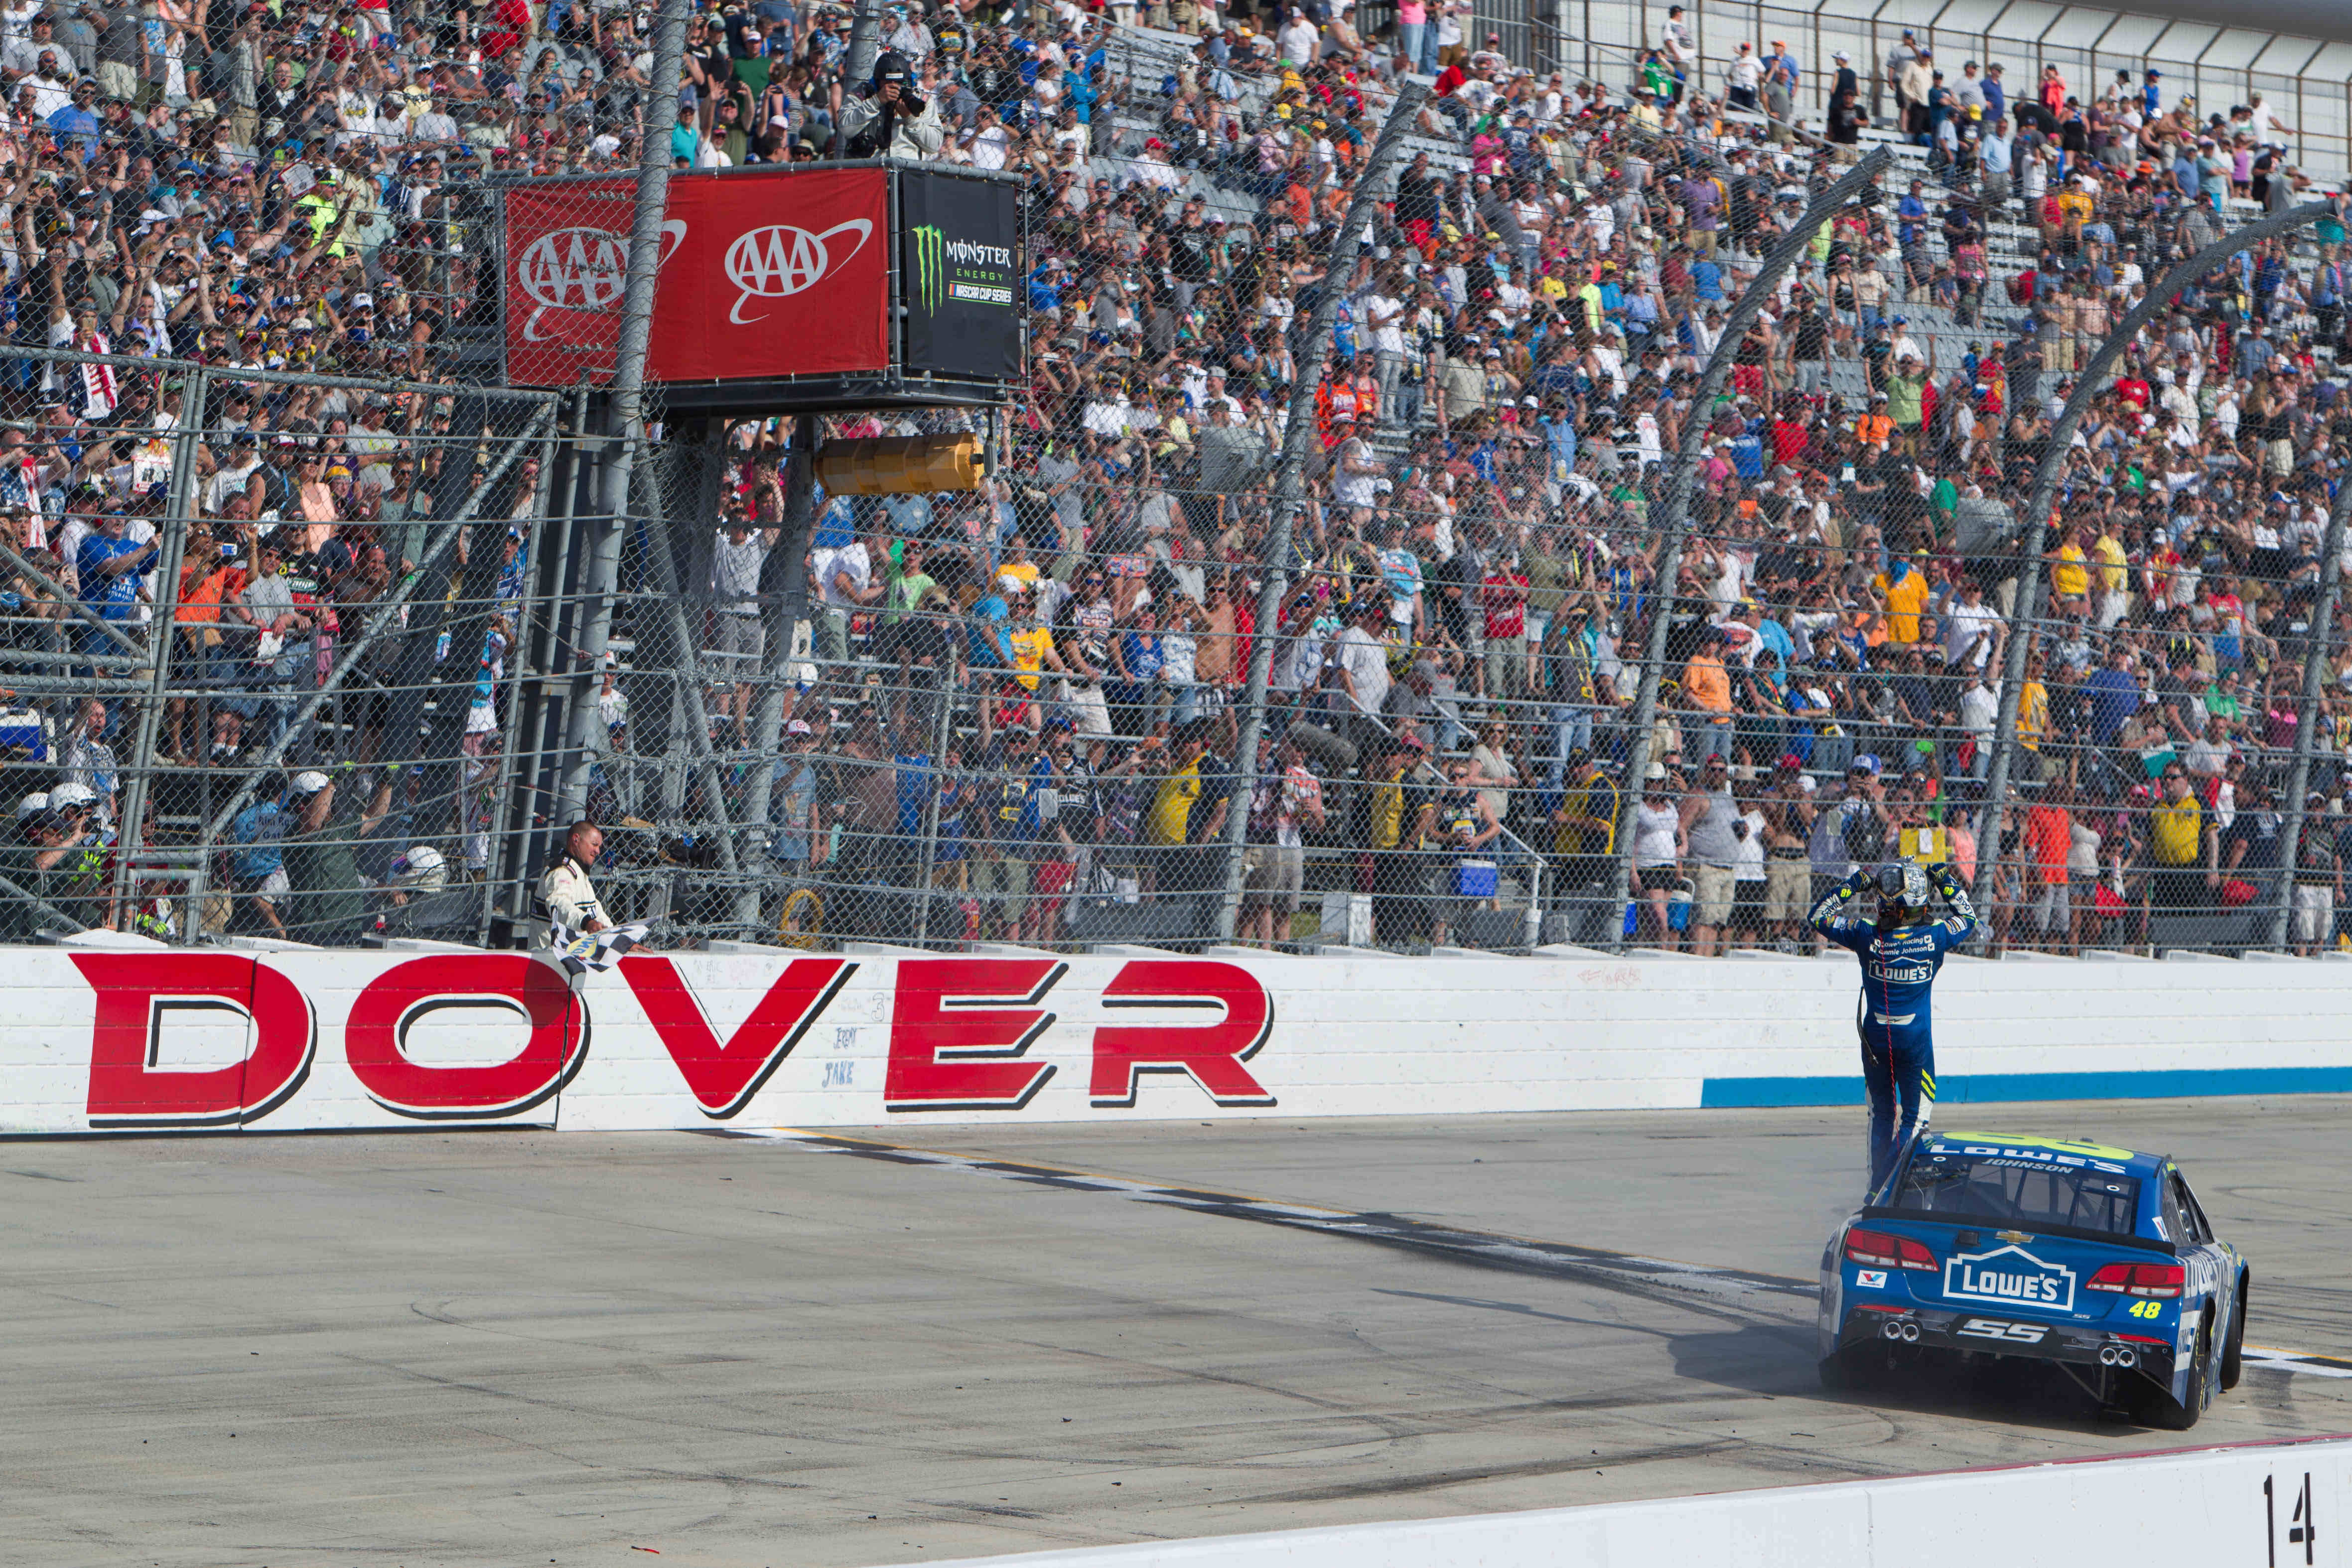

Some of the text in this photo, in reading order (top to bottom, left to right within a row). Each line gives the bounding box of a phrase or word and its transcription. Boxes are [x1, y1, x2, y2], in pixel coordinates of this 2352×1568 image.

[527, 228, 627, 306] AAA
[733, 227, 822, 294] AAA
[946, 239, 1011, 268] MONSTER
[957, 268, 1003, 281] ENERGY
[956, 284, 1012, 303] NASCAR CUP SERIES
[1875, 965, 1927, 980] LOWE'S
[68, 953, 1277, 1128] DOVER
[822, 1060, 854, 1088] JAKE
[1930, 1144, 2126, 1175] LOWE'S
[1981, 1158, 2074, 1174] JOHNSON
[1962, 1265, 2058, 1301] LOWE'S
[2129, 1300, 2162, 1319] 48
[1956, 1318, 2050, 1343] SS
[2263, 1472, 2315, 1568] 14
